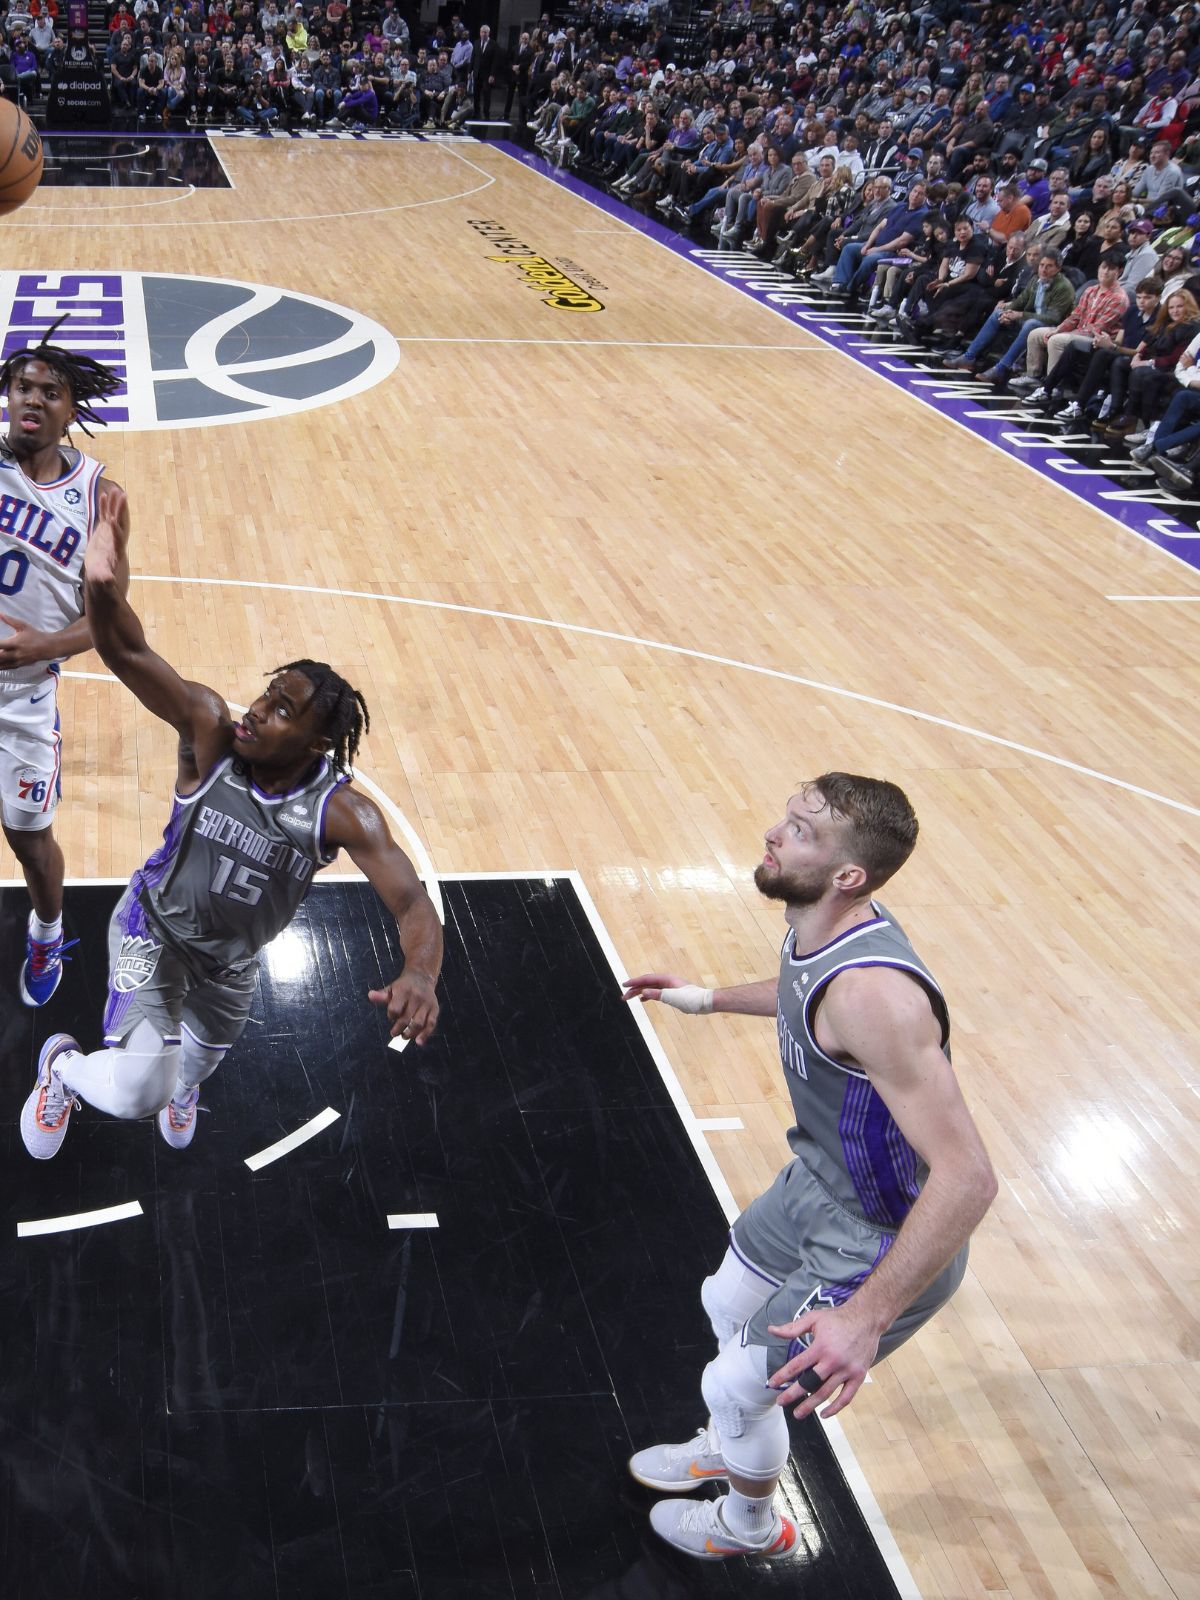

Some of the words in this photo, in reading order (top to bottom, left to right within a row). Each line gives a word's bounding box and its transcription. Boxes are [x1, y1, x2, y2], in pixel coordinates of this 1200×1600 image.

[69, 81, 101, 91] dialpad
[467, 219, 537, 256] CENTER
[688, 248, 845, 305] PROUD
[18, 778, 46, 803] 76
[280, 812, 313, 830] dialpad
[194, 805, 313, 882] SACRAMENTO
[210, 854, 270, 906] 15
[116, 958, 155, 974] KINGS
